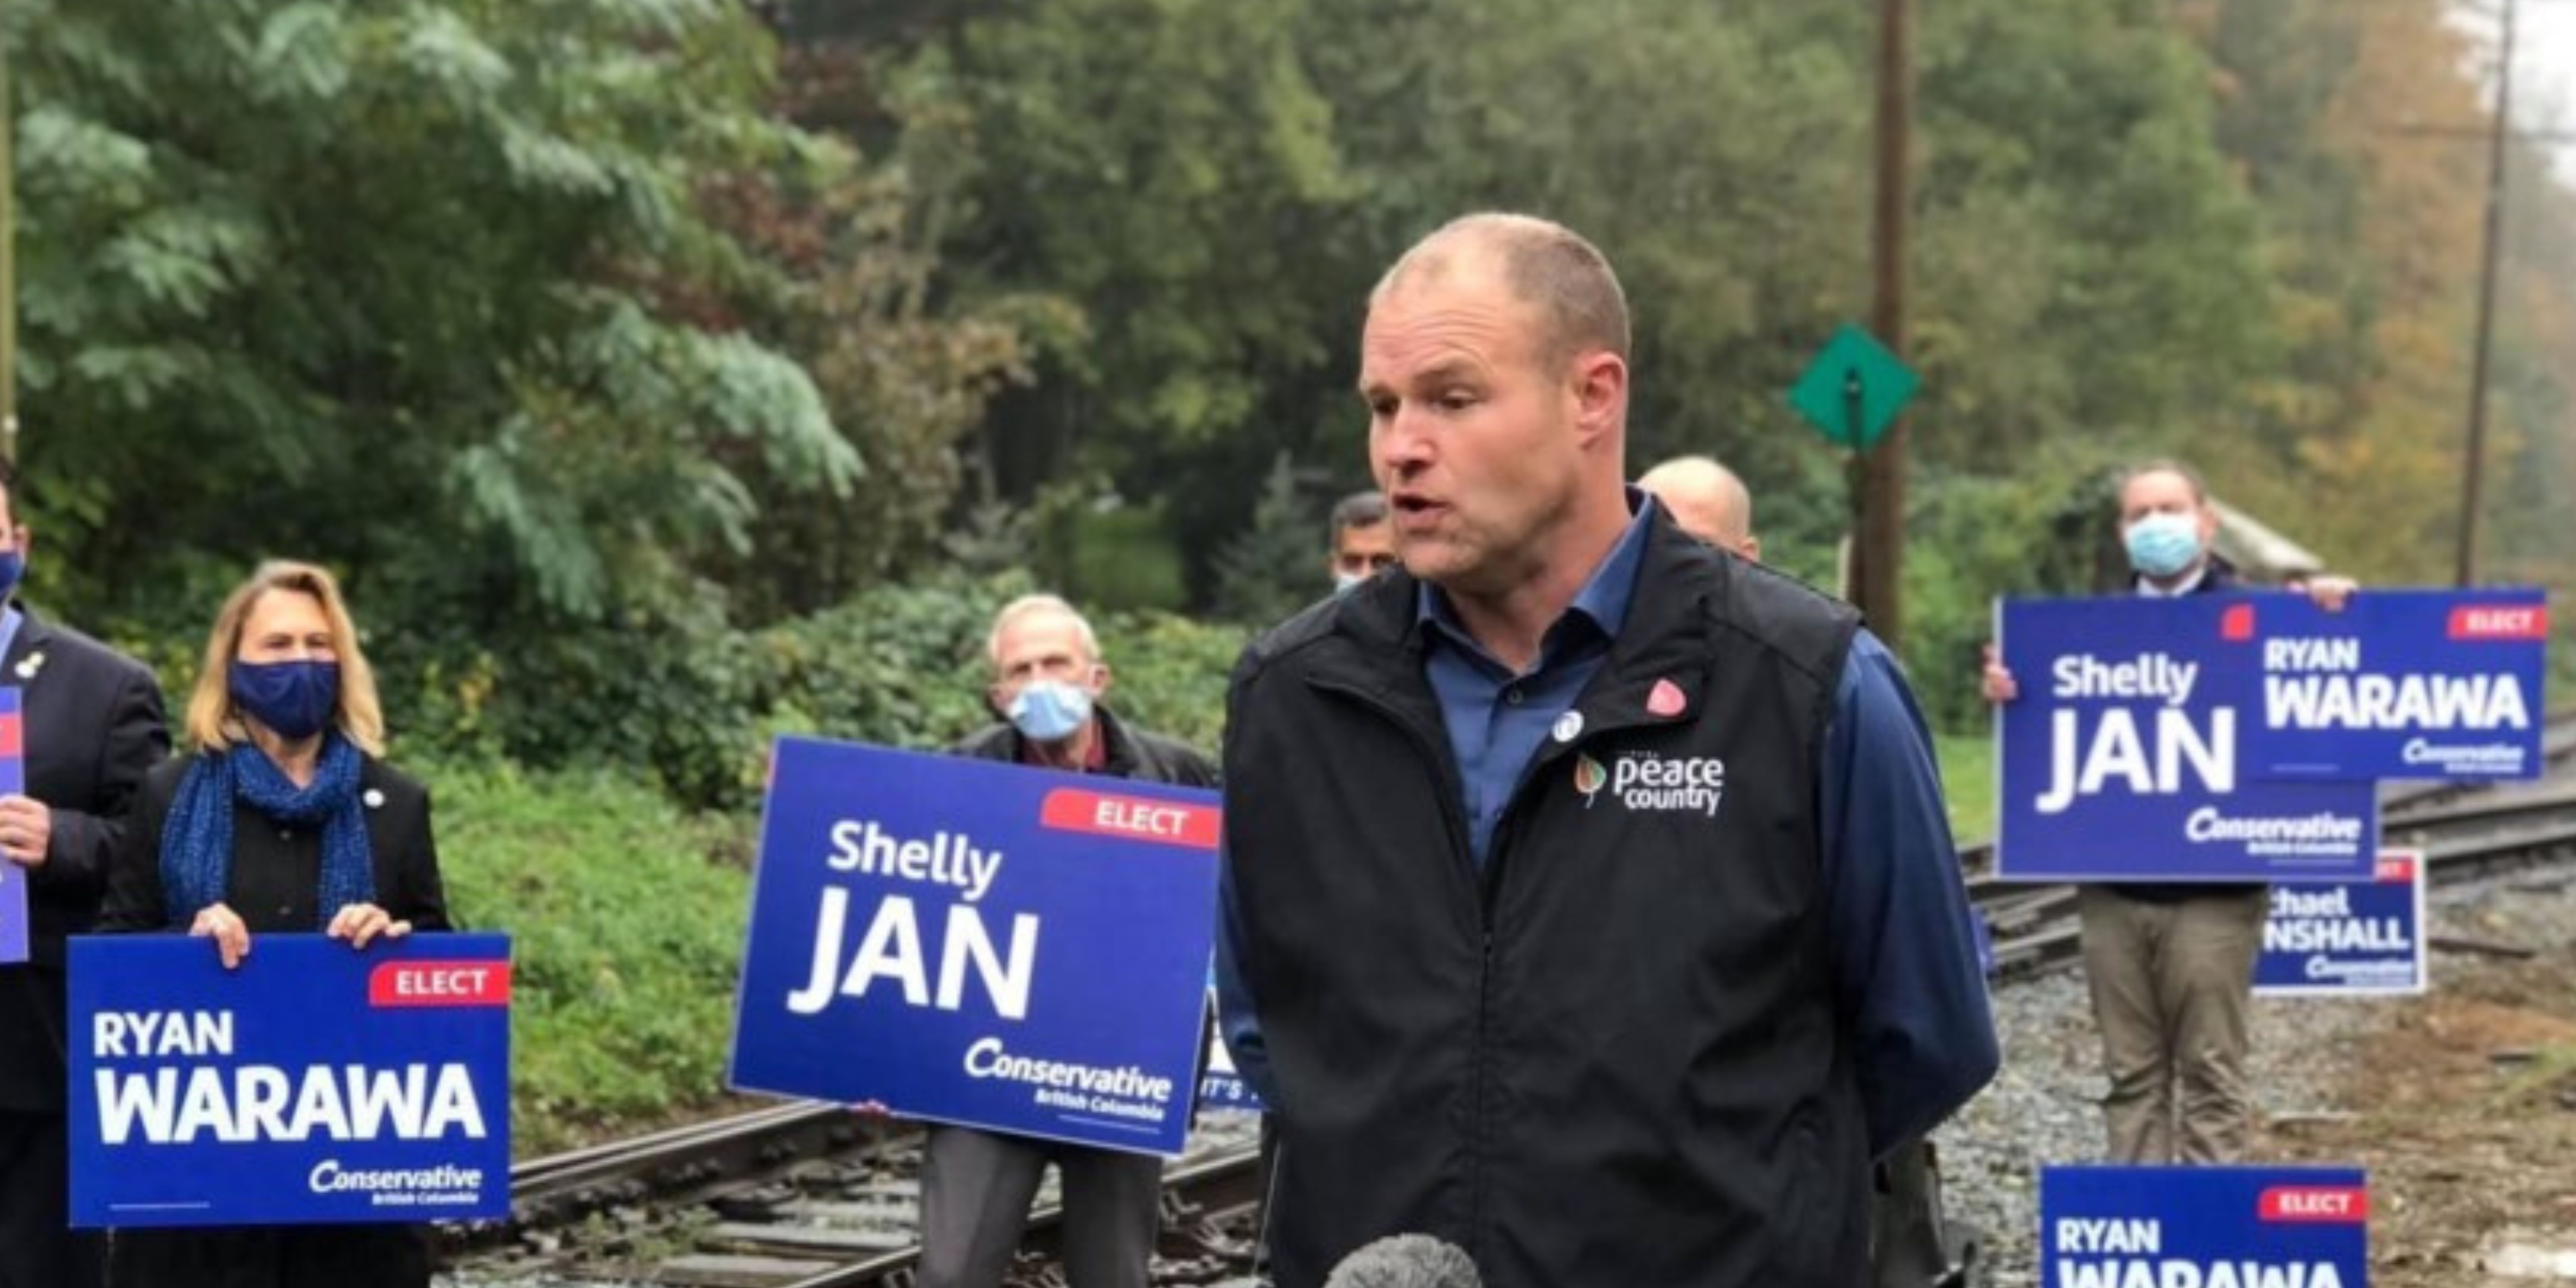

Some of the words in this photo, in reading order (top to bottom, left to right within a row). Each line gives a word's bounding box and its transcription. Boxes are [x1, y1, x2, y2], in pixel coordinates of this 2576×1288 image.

[2466, 610, 2533, 632] ELECT
[2264, 638, 2359, 670] RYAN
[2052, 653, 2197, 703] Shelly
[2264, 674, 2528, 728] WARAWA
[1614, 757, 1724, 795] peace
[2035, 707, 2235, 813] JAN
[1095, 799, 1189, 835] ELECT
[1624, 786, 1721, 816] country
[2185, 806, 2361, 842] Conservative
[826, 820, 1003, 901] Shelly
[786, 886, 1039, 1020] JAN
[396, 969, 488, 995] ELECT
[93, 1010, 233, 1057] RYAN
[964, 1036, 1172, 1102] Conservative
[94, 1063, 486, 1144] WARAWA
[309, 1159, 482, 1193] Conservative
[2278, 1193, 2351, 1214] ELECT
[2056, 1218, 2160, 1254] RYAN
